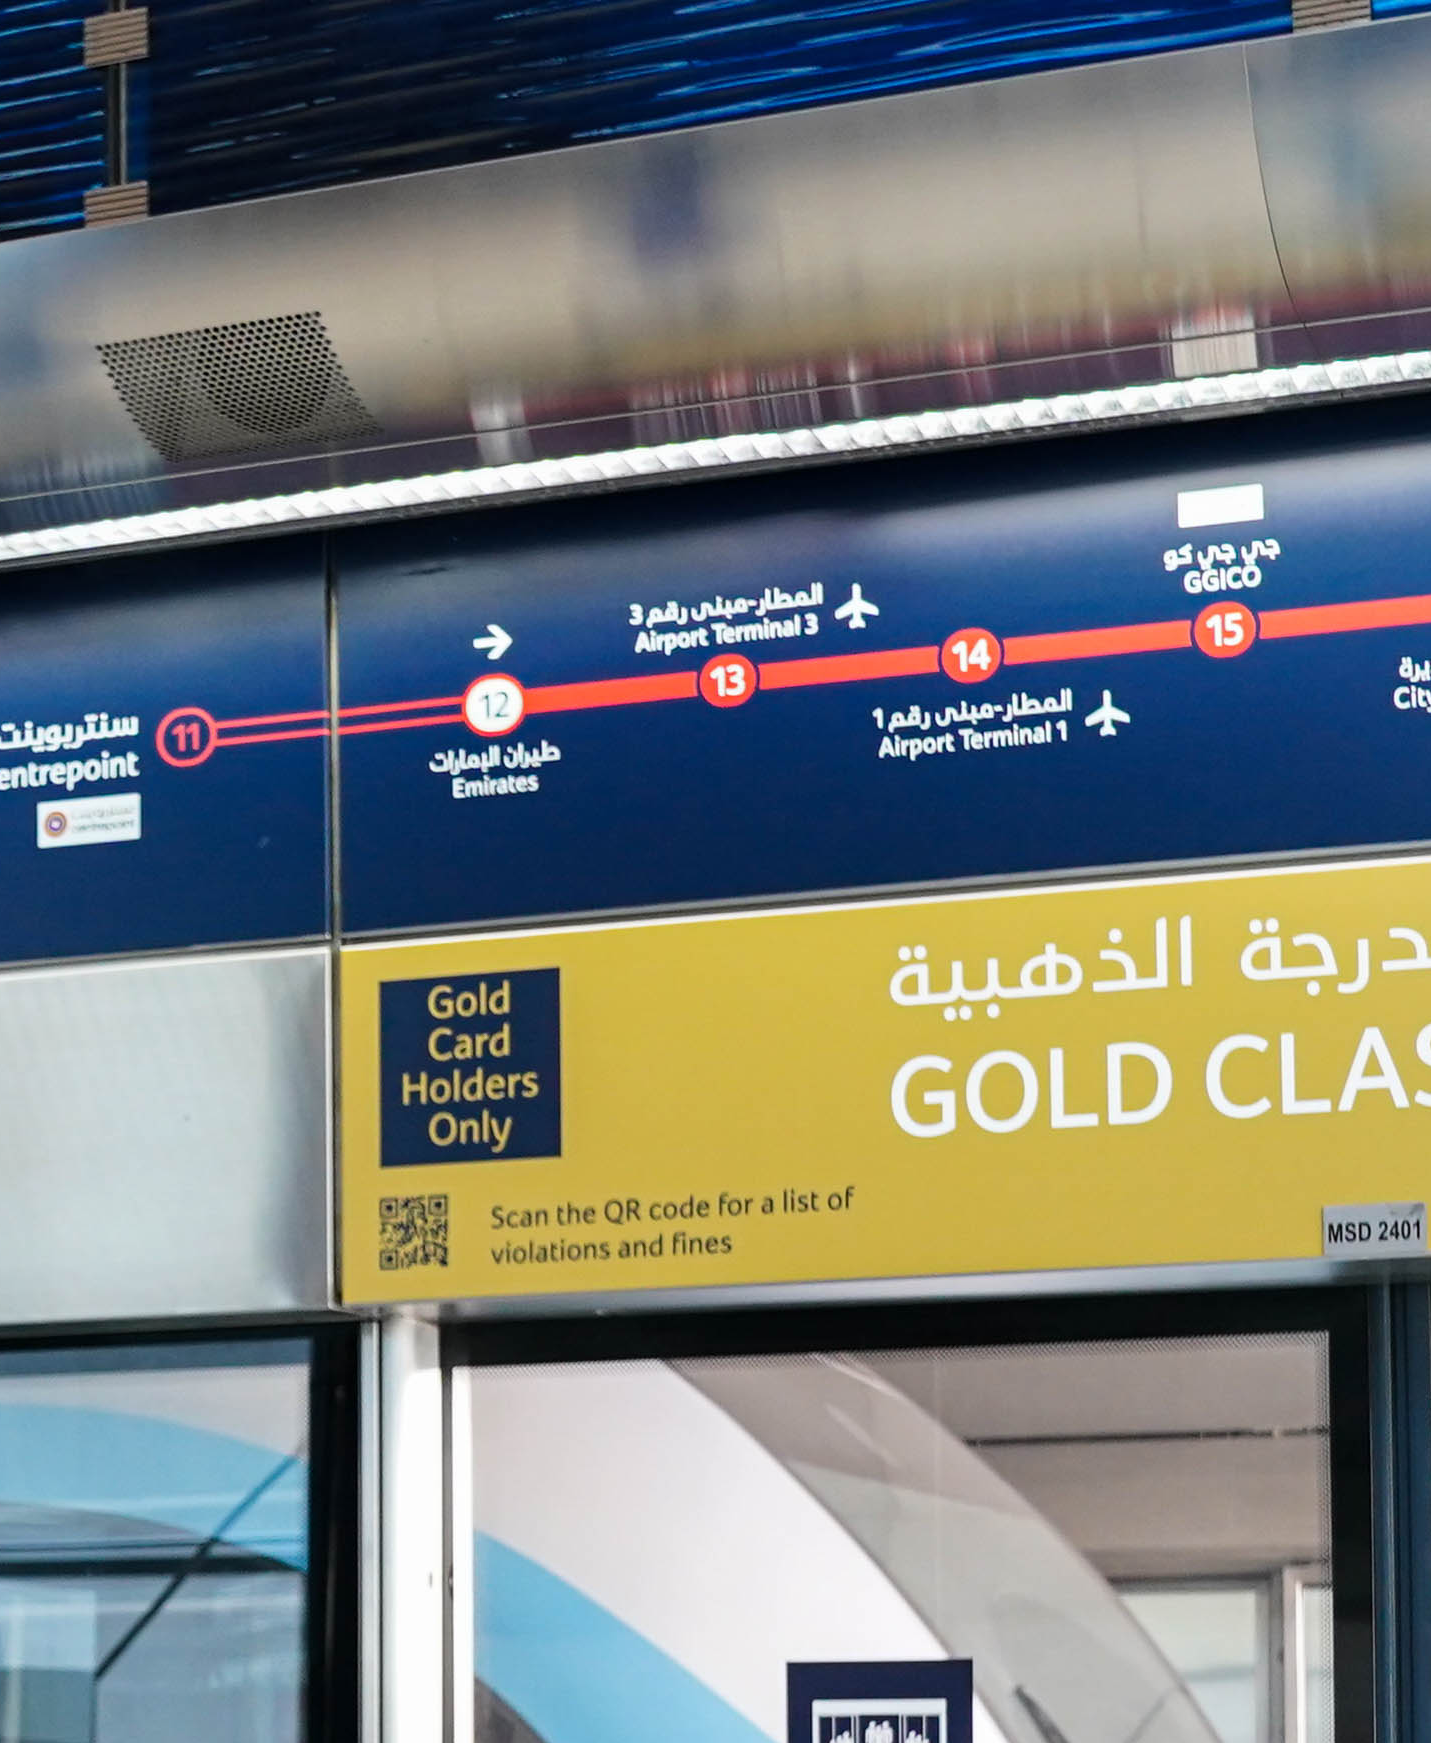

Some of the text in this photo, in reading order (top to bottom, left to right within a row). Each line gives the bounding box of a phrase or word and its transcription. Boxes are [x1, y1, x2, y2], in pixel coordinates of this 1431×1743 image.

[1162, 537, 1282, 572] جي جي كو
[1183, 564, 1262, 595] GGICO
[628, 603, 644, 626] 3
[644, 600, 689, 630] رقم
[1205, 611, 1245, 648] 15
[634, 612, 819, 657] Airport Terminal 3
[951, 637, 991, 673] 14
[710, 663, 746, 698] 13
[480, 690, 510, 720] 12
[871, 706, 884, 730] 1
[887, 705, 932, 734] رقم
[171, 721, 202, 753] 11
[503, 738, 562, 770] طيران
[878, 719, 1068, 762] Airport Terminal 1
[451, 772, 539, 799] Emirates
[889, 912, 1193, 1022] الذهبية
[427, 980, 511, 1020] Gold
[427, 1023, 511, 1064] Card
[401, 1066, 539, 1107] Holders
[889, 1041, 1174, 1140] GOLD
[428, 1109, 513, 1153] Only
[490, 1186, 856, 1231] Scan the QR code for a list of
[490, 1230, 733, 1265] violations and fines
[1327, 1218, 1421, 1244] MSD 2401
